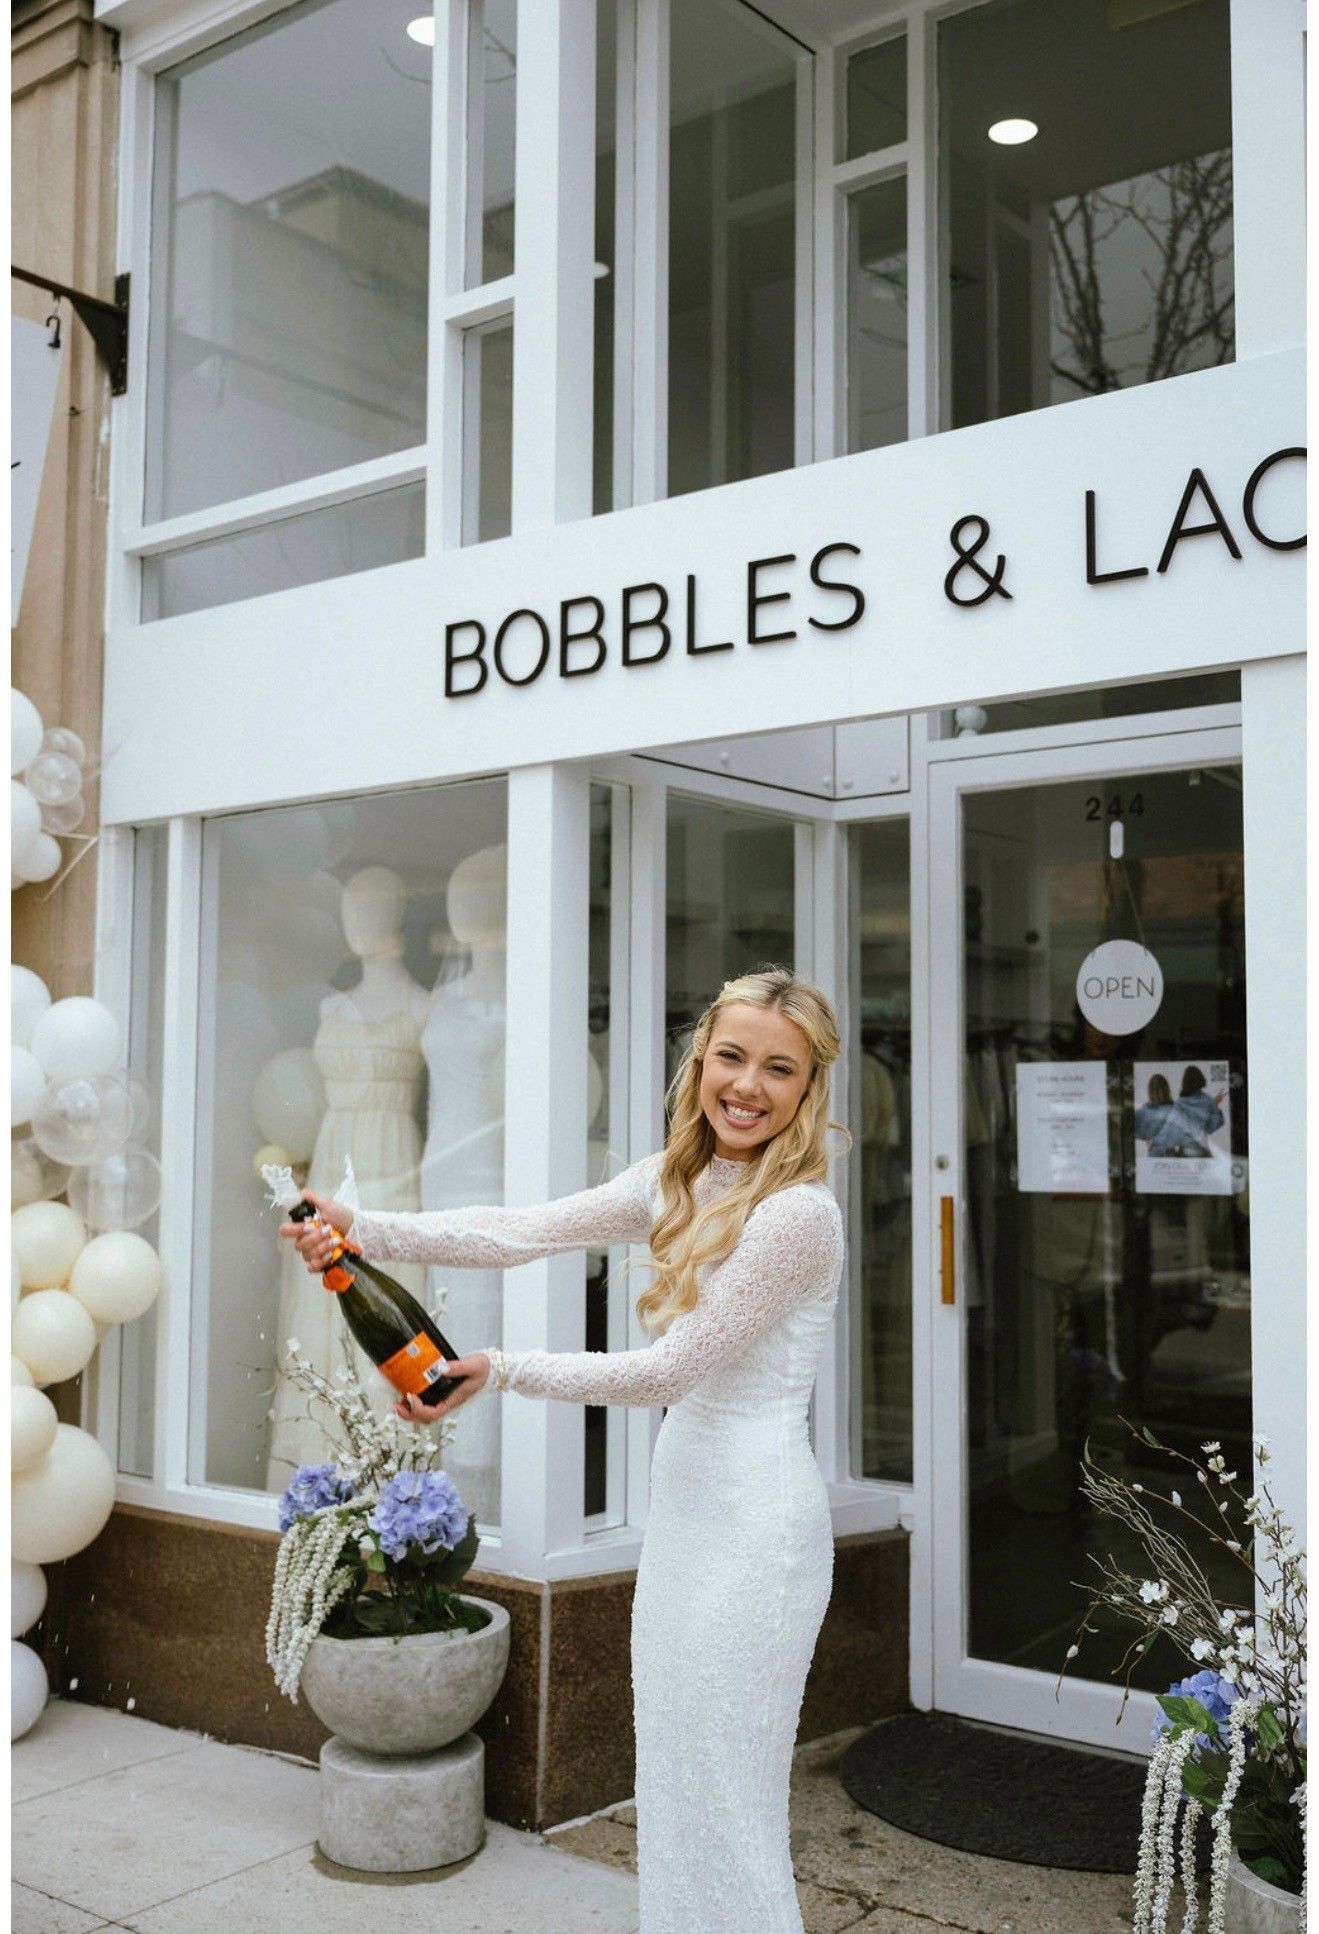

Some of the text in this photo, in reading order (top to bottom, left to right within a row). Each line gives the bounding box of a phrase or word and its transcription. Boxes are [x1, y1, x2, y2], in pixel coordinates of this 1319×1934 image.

[444, 541, 866, 699] BOBBLES
[943, 514, 1014, 608] &
[1085, 794, 1145, 821] 244
[1084, 976, 1155, 999] OPEN
